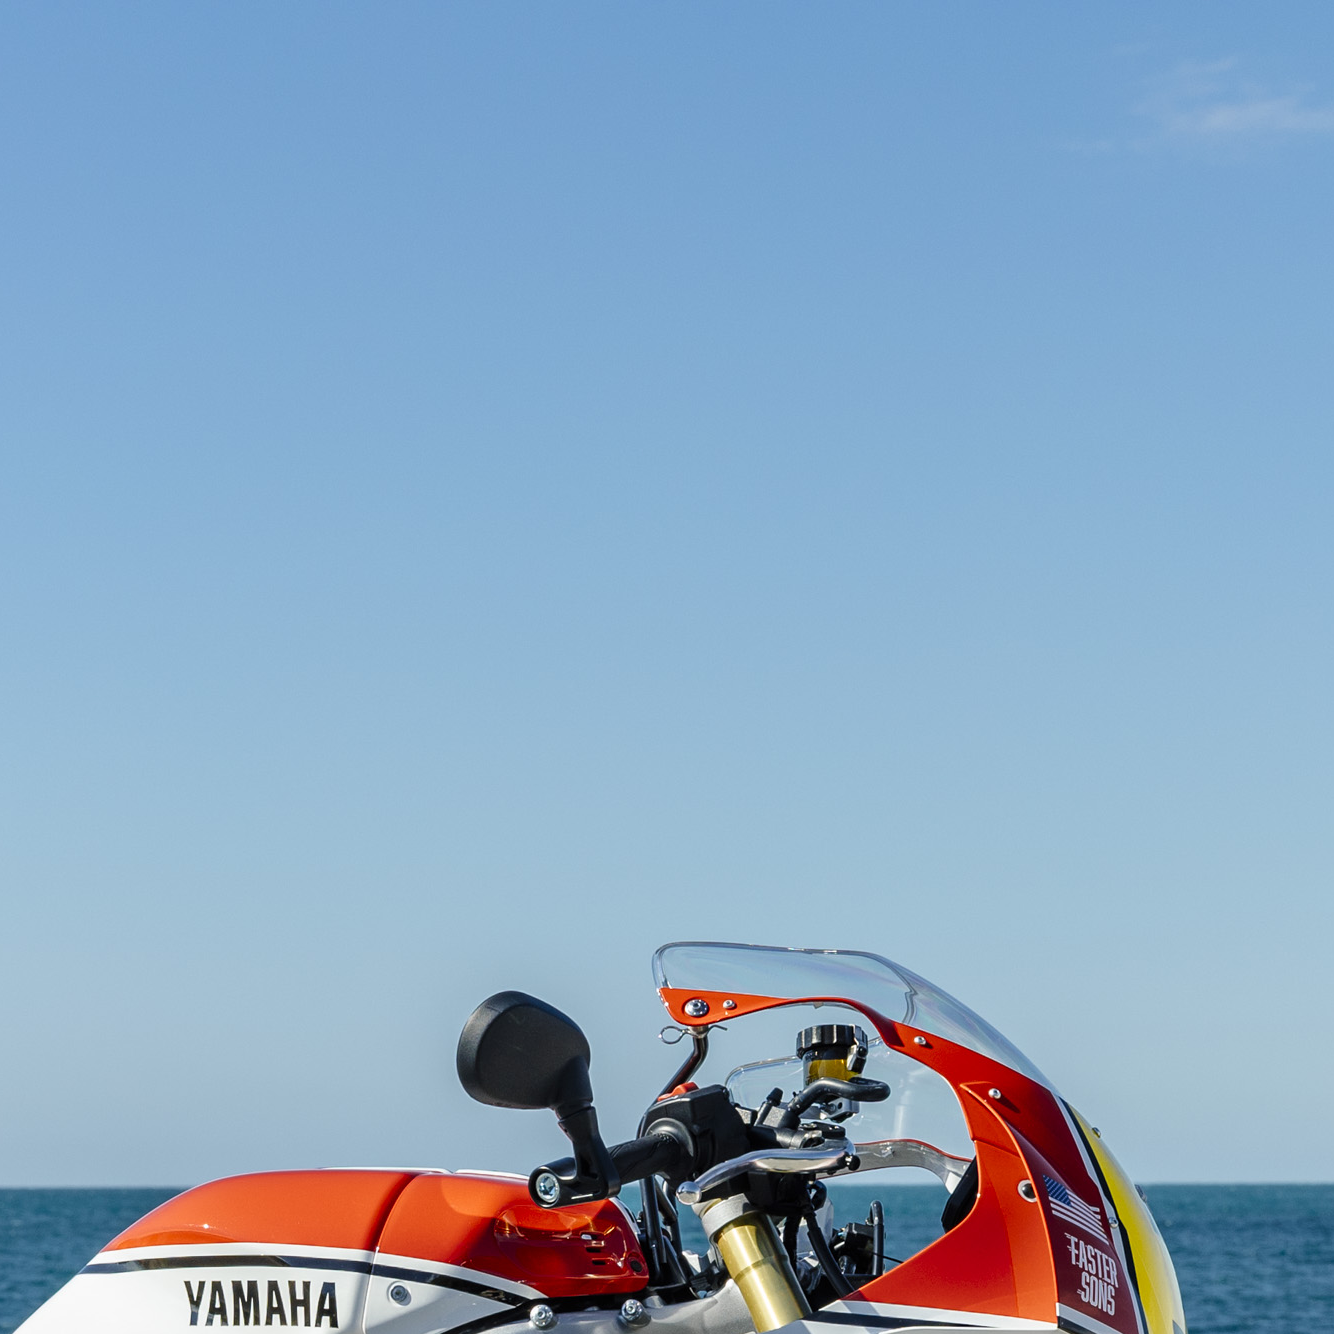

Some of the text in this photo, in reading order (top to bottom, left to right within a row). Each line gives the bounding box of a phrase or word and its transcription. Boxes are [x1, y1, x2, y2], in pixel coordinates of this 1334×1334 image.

[1067, 1234, 1119, 1289] FASTER
[183, 1280, 339, 1329] YAMAHA
[1078, 1271, 1116, 1316] SONS
